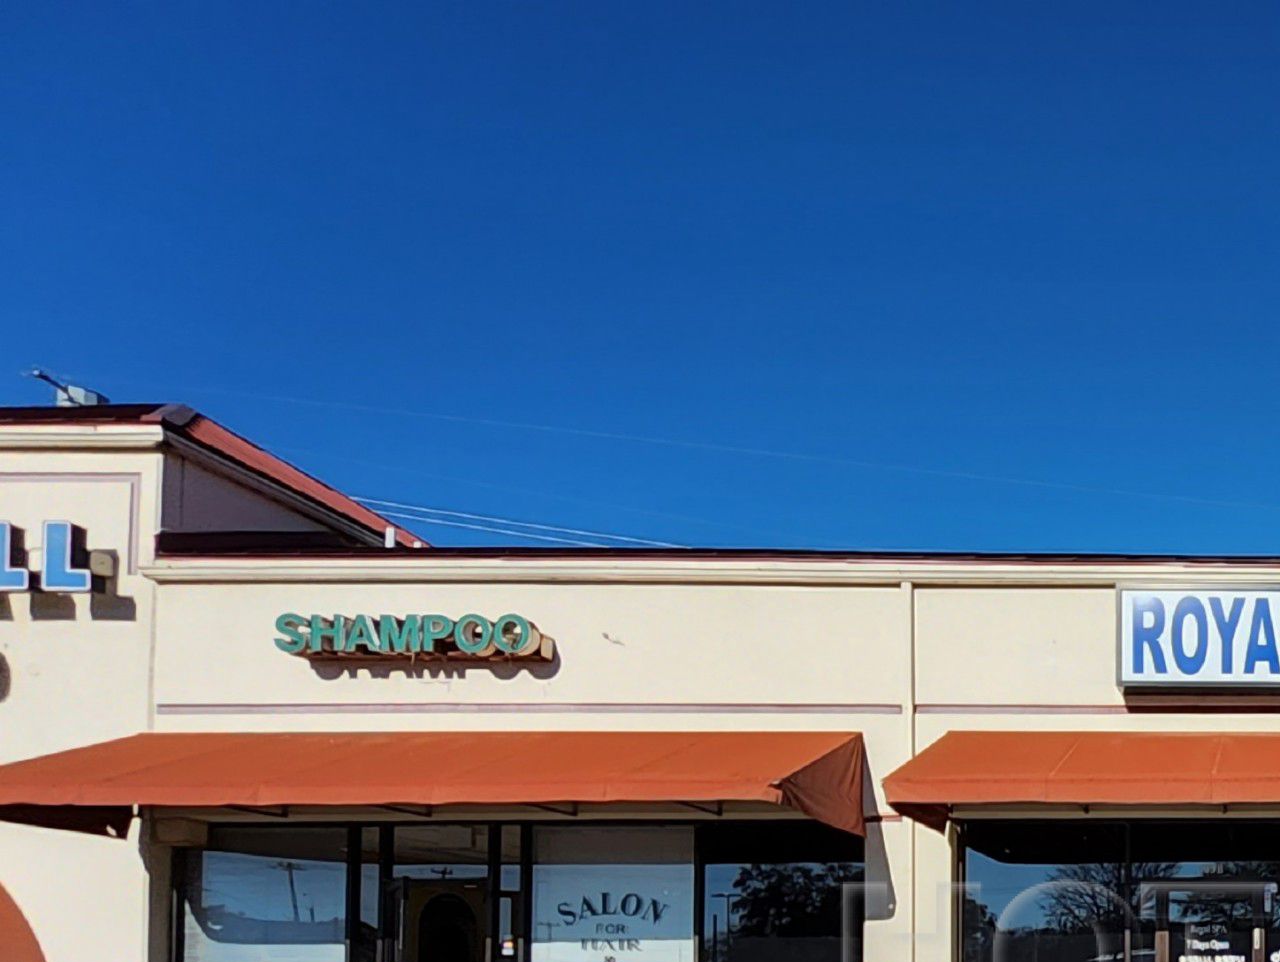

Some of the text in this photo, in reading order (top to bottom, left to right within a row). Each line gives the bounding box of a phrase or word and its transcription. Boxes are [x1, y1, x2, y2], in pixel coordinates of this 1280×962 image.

[274, 612, 531, 654] SHAMPOO
[557, 891, 671, 926] SALON
[595, 923, 626, 935] FOR
[581, 937, 644, 952] HAIR
